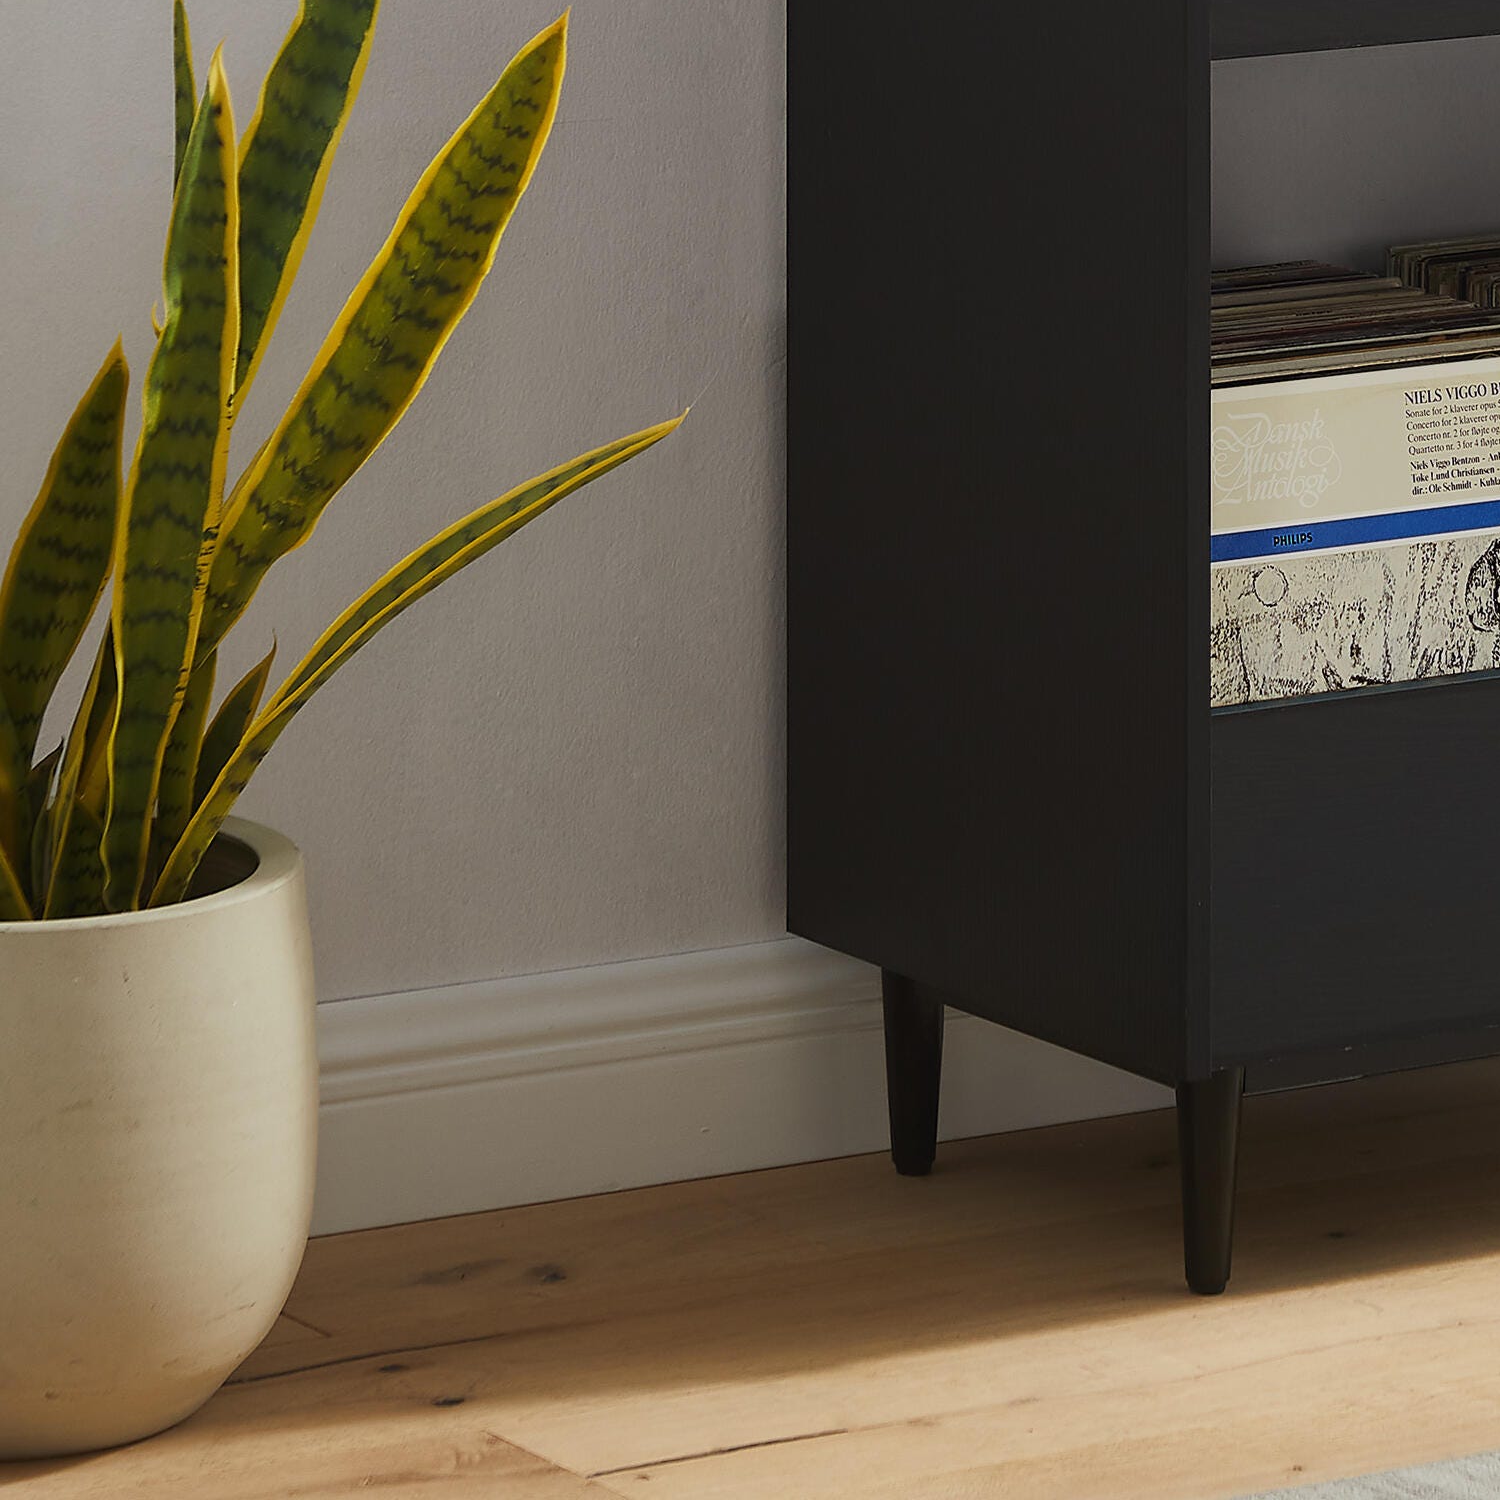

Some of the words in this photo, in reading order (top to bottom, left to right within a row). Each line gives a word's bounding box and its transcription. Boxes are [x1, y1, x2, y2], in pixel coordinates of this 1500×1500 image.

[1405, 388, 1442, 405] NIELS
[1446, 384, 1487, 399] VIGGO
[1406, 409, 1430, 418] Sonate
[1432, 407, 1442, 415] for
[1444, 406, 1448, 414] 2
[1450, 404, 1478, 413] klaverer
[1480, 403, 1496, 411] opus
[1407, 420, 1440, 430] Concerto
[1442, 418, 1452, 426] for
[1454, 417, 1457, 425] 2
[1460, 415, 1488, 424] klaverer
[1407, 432, 1441, 443] Concerto
[1454, 429, 1458, 437] 2
[1408, 444, 1444, 455] Quartetto
[1457, 441, 1461, 450] 3
[1463, 440, 1473, 448] for
[1411, 461, 1428, 470] Niels
[1430, 459, 1450, 469] Viggo
[1452, 456, 1480, 465] Bentzon
[1411, 473, 1429, 483] Toke
[1431, 470, 1449, 481] Lund
[1451, 467, 1494, 478] Christiansen
[1429, 484, 1442, 493] Ole
[1443, 480, 1471, 491] Schmidt
[1273, 533, 1313, 546] PHILIPS
